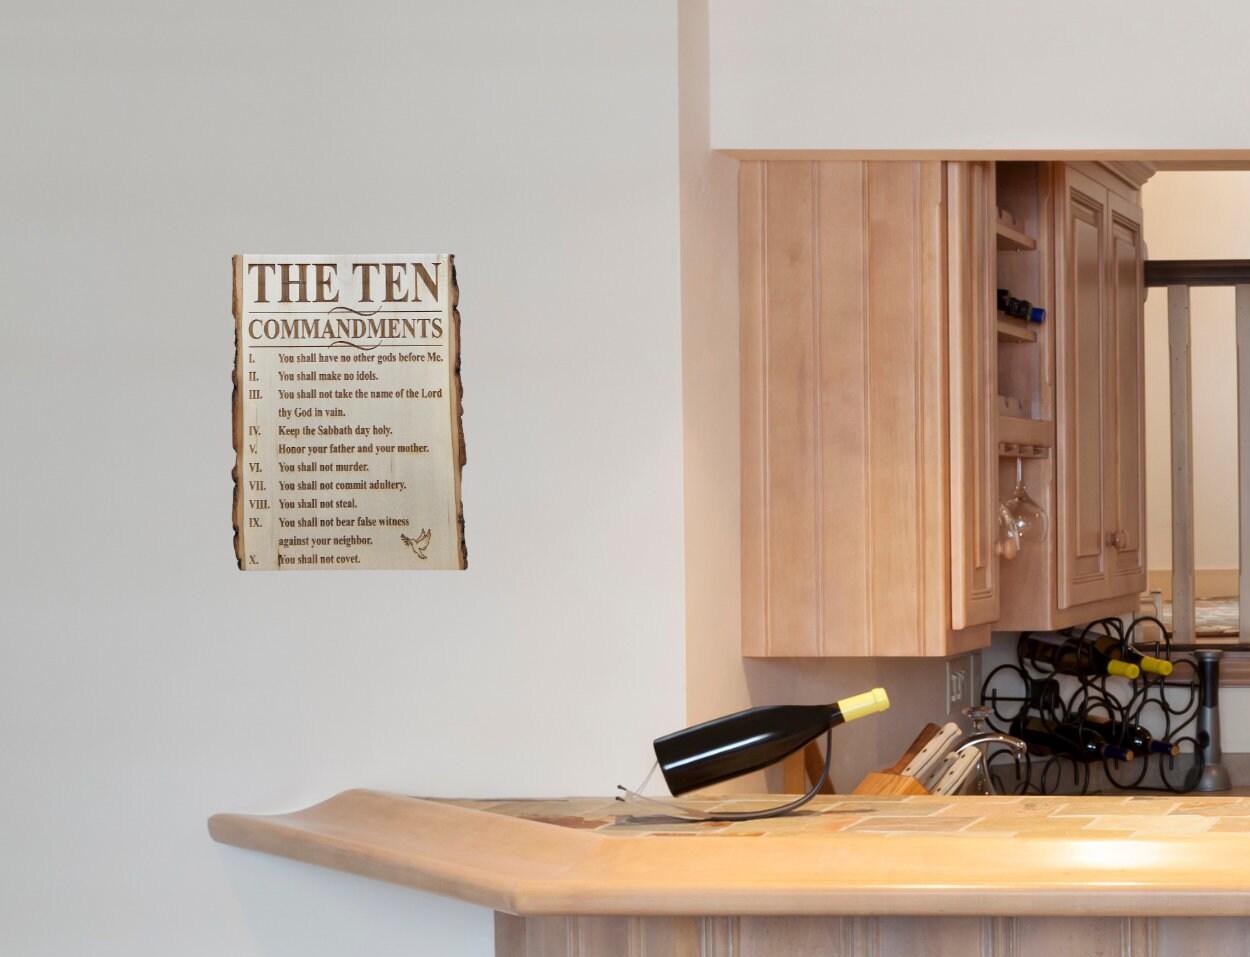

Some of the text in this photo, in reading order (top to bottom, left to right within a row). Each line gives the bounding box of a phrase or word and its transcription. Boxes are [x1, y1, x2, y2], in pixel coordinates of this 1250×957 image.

[248, 262, 442, 304] THE TEN
[248, 317, 443, 340] COMMANDMENTS
[249, 352, 444, 365] I. You shall have no other gods before Me.
[248, 370, 379, 382] II. You shall make no idols.
[249, 388, 443, 400] III. You shall not take the name of the Lord
[278, 407, 346, 419] thy God in vain.
[249, 425, 393, 438] IV. Keep the Sabbath day holy.
[249, 443, 430, 456] V. Honor your father and your mother.
[249, 461, 369, 473] VI. You shall not murder.
[249, 479, 407, 492] VII. You shall not commit adultery.
[249, 498, 358, 510] VIII. You shall not steal.
[249, 516, 410, 528] IX. You shall not bear false witness
[278, 535, 373, 548] against your neighbor.
[249, 554, 361, 565] X. You shall not covet.
